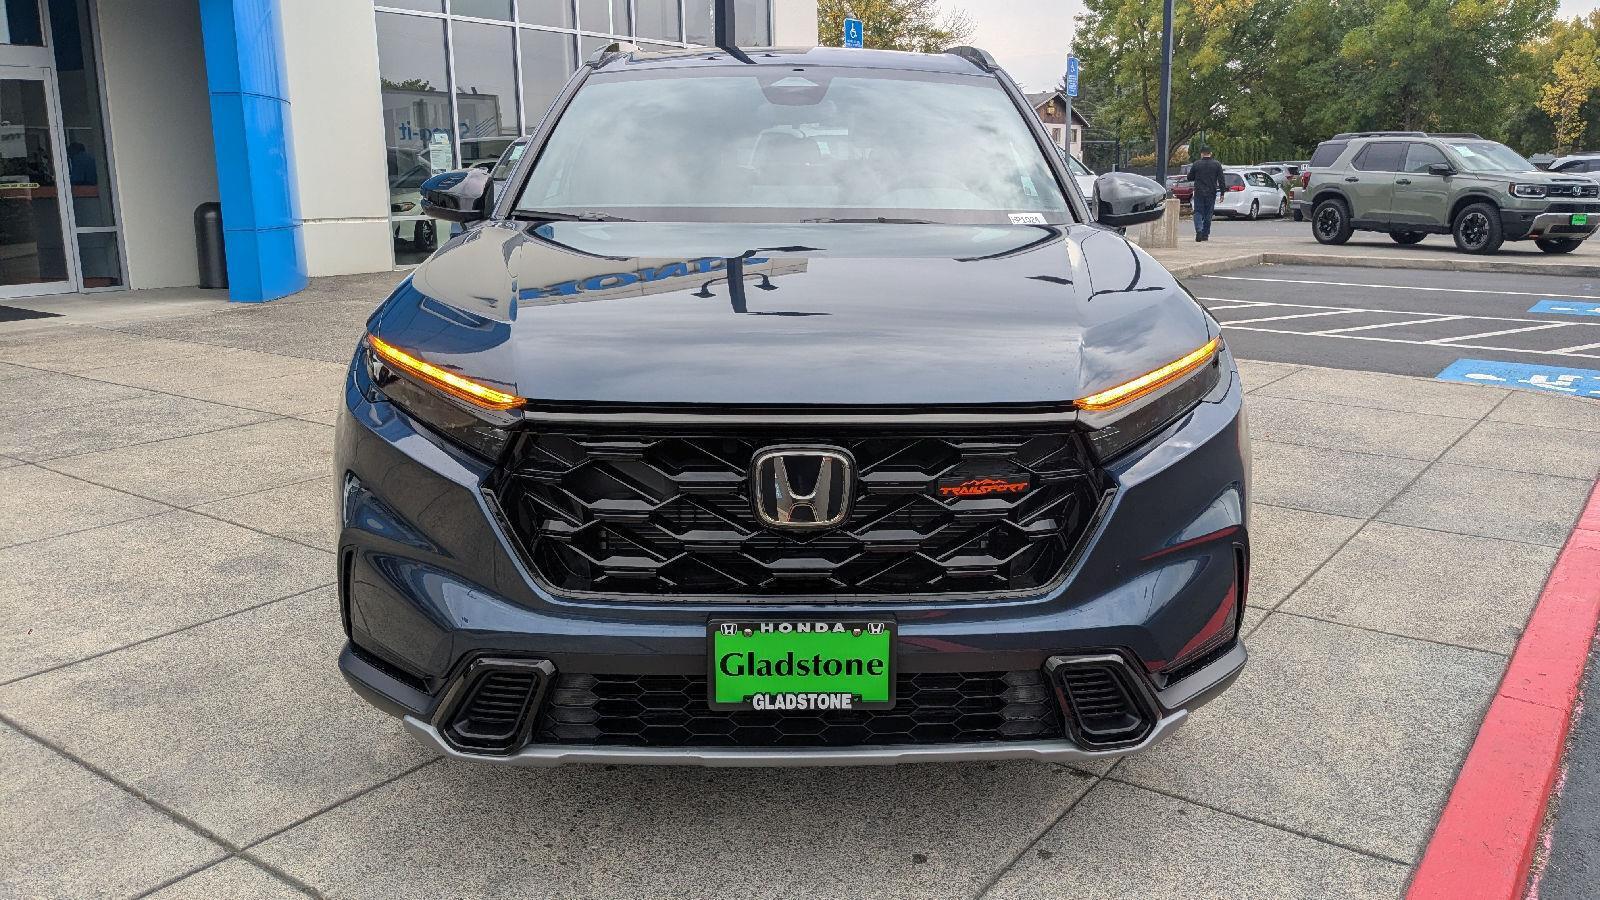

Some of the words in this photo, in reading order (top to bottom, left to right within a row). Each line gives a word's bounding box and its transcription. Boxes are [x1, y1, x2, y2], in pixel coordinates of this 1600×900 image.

[939, 481, 1028, 497] TRAILSPORT
[760, 622, 846, 633] HONDA
[719, 651, 884, 677] Gladstone
[752, 693, 852, 710] GLADSTONE
